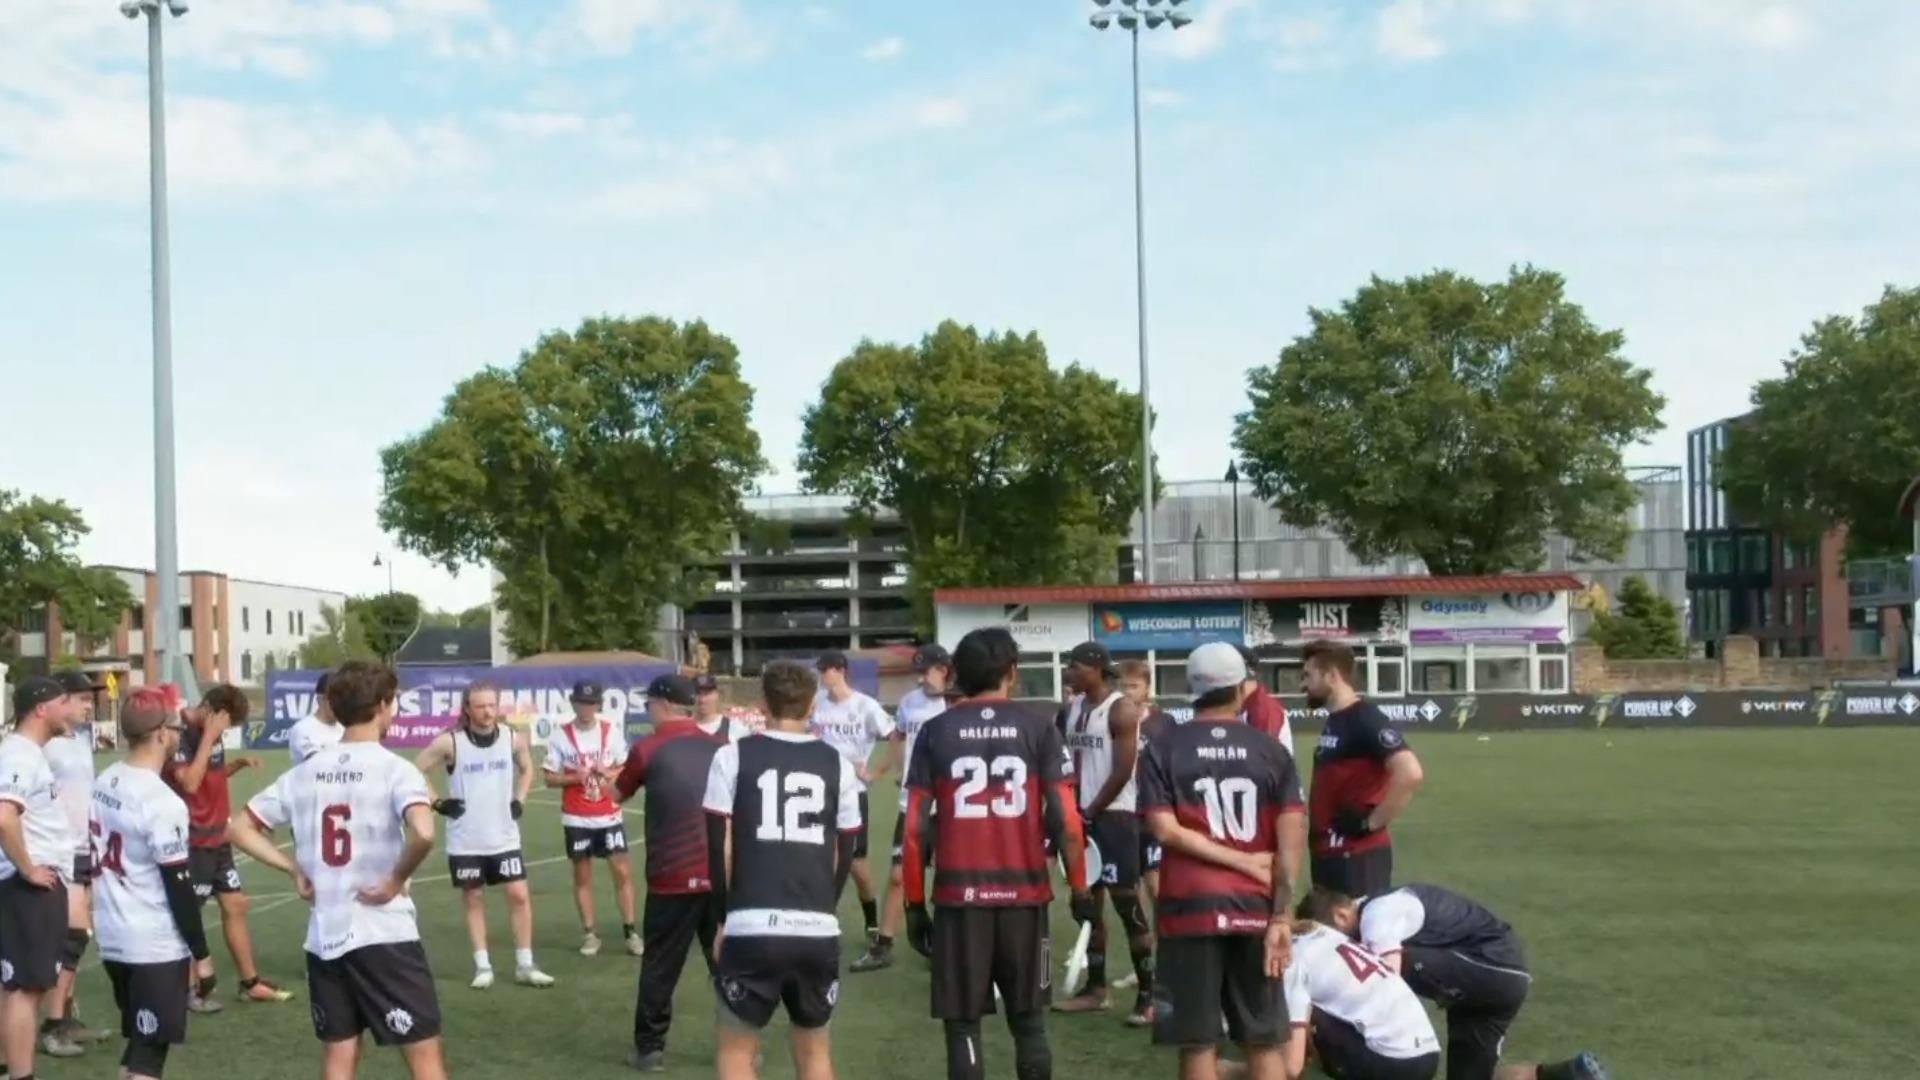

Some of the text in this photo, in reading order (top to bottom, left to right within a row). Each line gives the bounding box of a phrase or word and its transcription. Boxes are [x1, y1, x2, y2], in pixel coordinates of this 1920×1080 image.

[1299, 603, 1352, 628] JUST
[1421, 600, 1488, 614] Odyssey
[1128, 616, 1241, 630] WISCONSIN LOTTERY
[431, 688, 652, 717] FLMINOS
[1624, 700, 1674, 713] POWER UP
[1846, 697, 1897, 709] POWER UP
[315, 771, 364, 784] MORENO
[950, 755, 1028, 819] 23
[755, 768, 827, 845] 12
[1193, 776, 1258, 843] 10
[321, 803, 352, 867] 6
